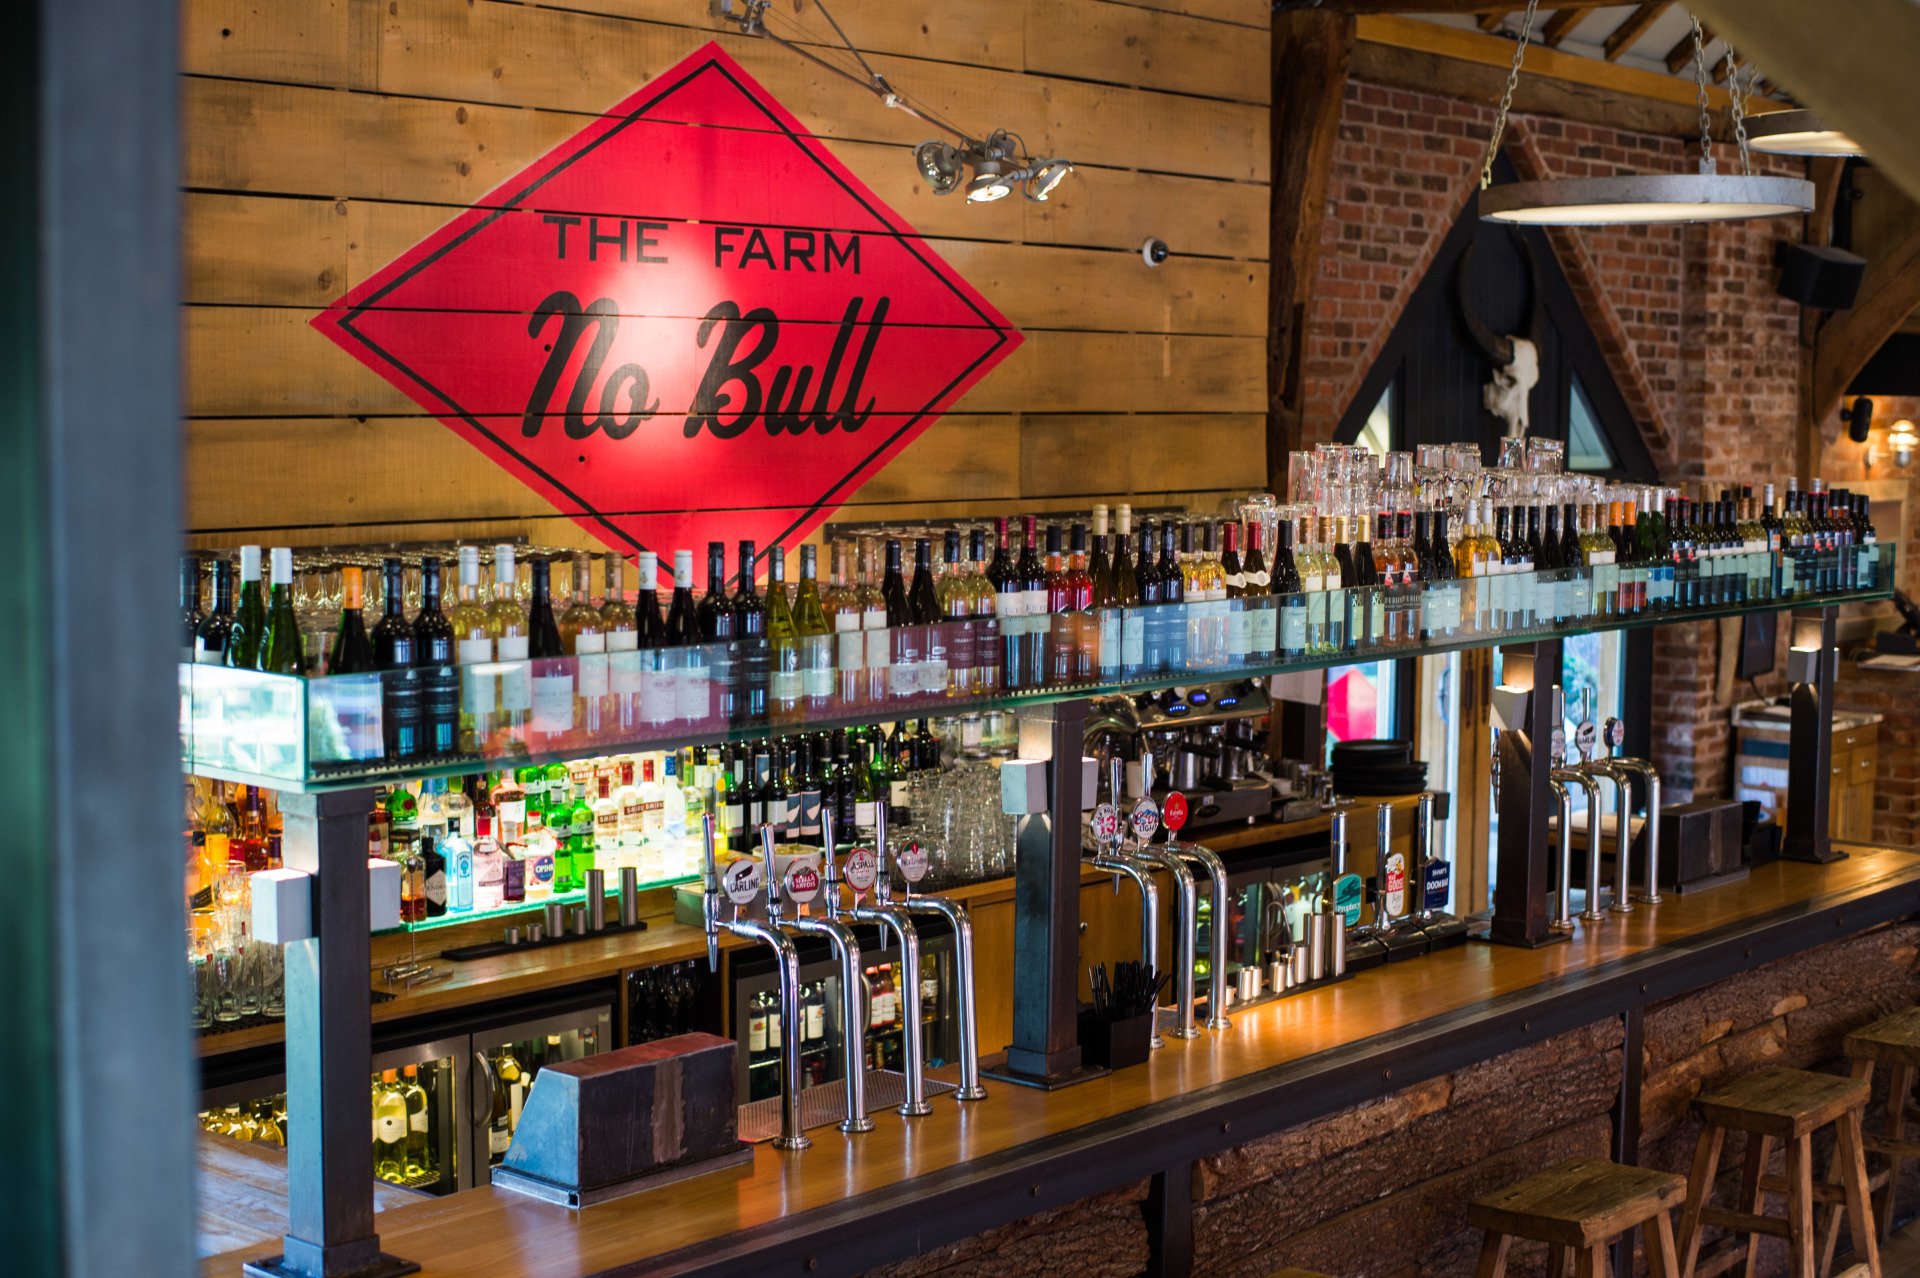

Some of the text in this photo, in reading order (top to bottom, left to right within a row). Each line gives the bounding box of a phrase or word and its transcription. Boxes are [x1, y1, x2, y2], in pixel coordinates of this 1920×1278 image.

[543, 215, 861, 274] THE FARM
[521, 290, 891, 441] No Bull
[1100, 815, 1116, 834] 13
[730, 878, 760, 893] CARLING
